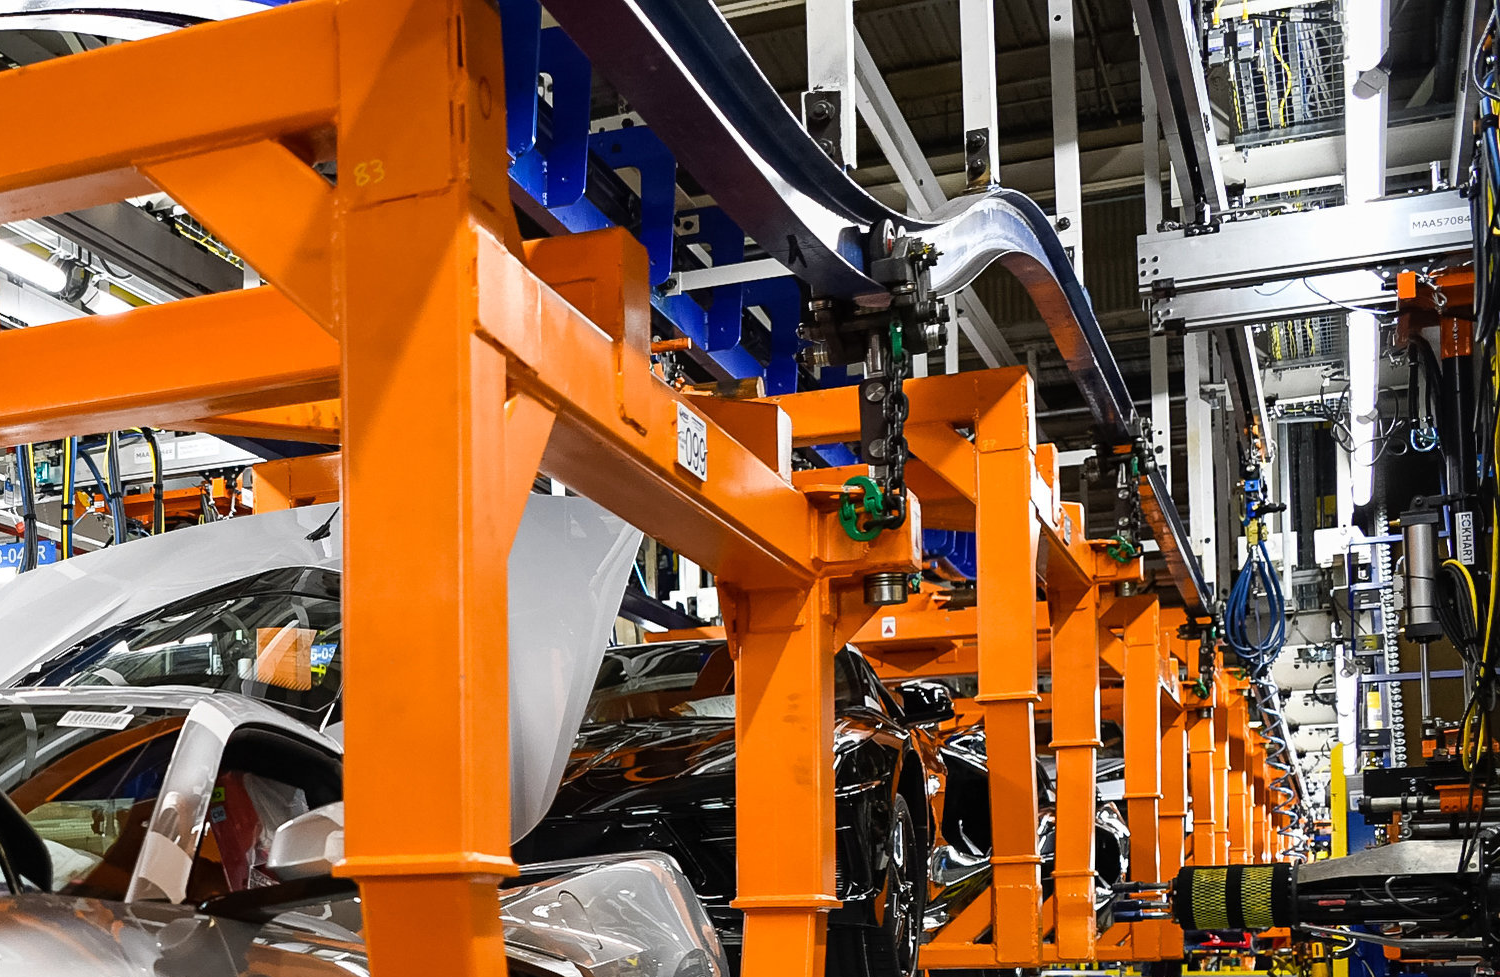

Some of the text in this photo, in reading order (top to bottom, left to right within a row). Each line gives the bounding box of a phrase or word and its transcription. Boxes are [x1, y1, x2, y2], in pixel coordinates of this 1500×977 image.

[354, 159, 385, 187] 83
[686, 427, 706, 476] 099
[1461, 513, 1473, 563] ECKHART
